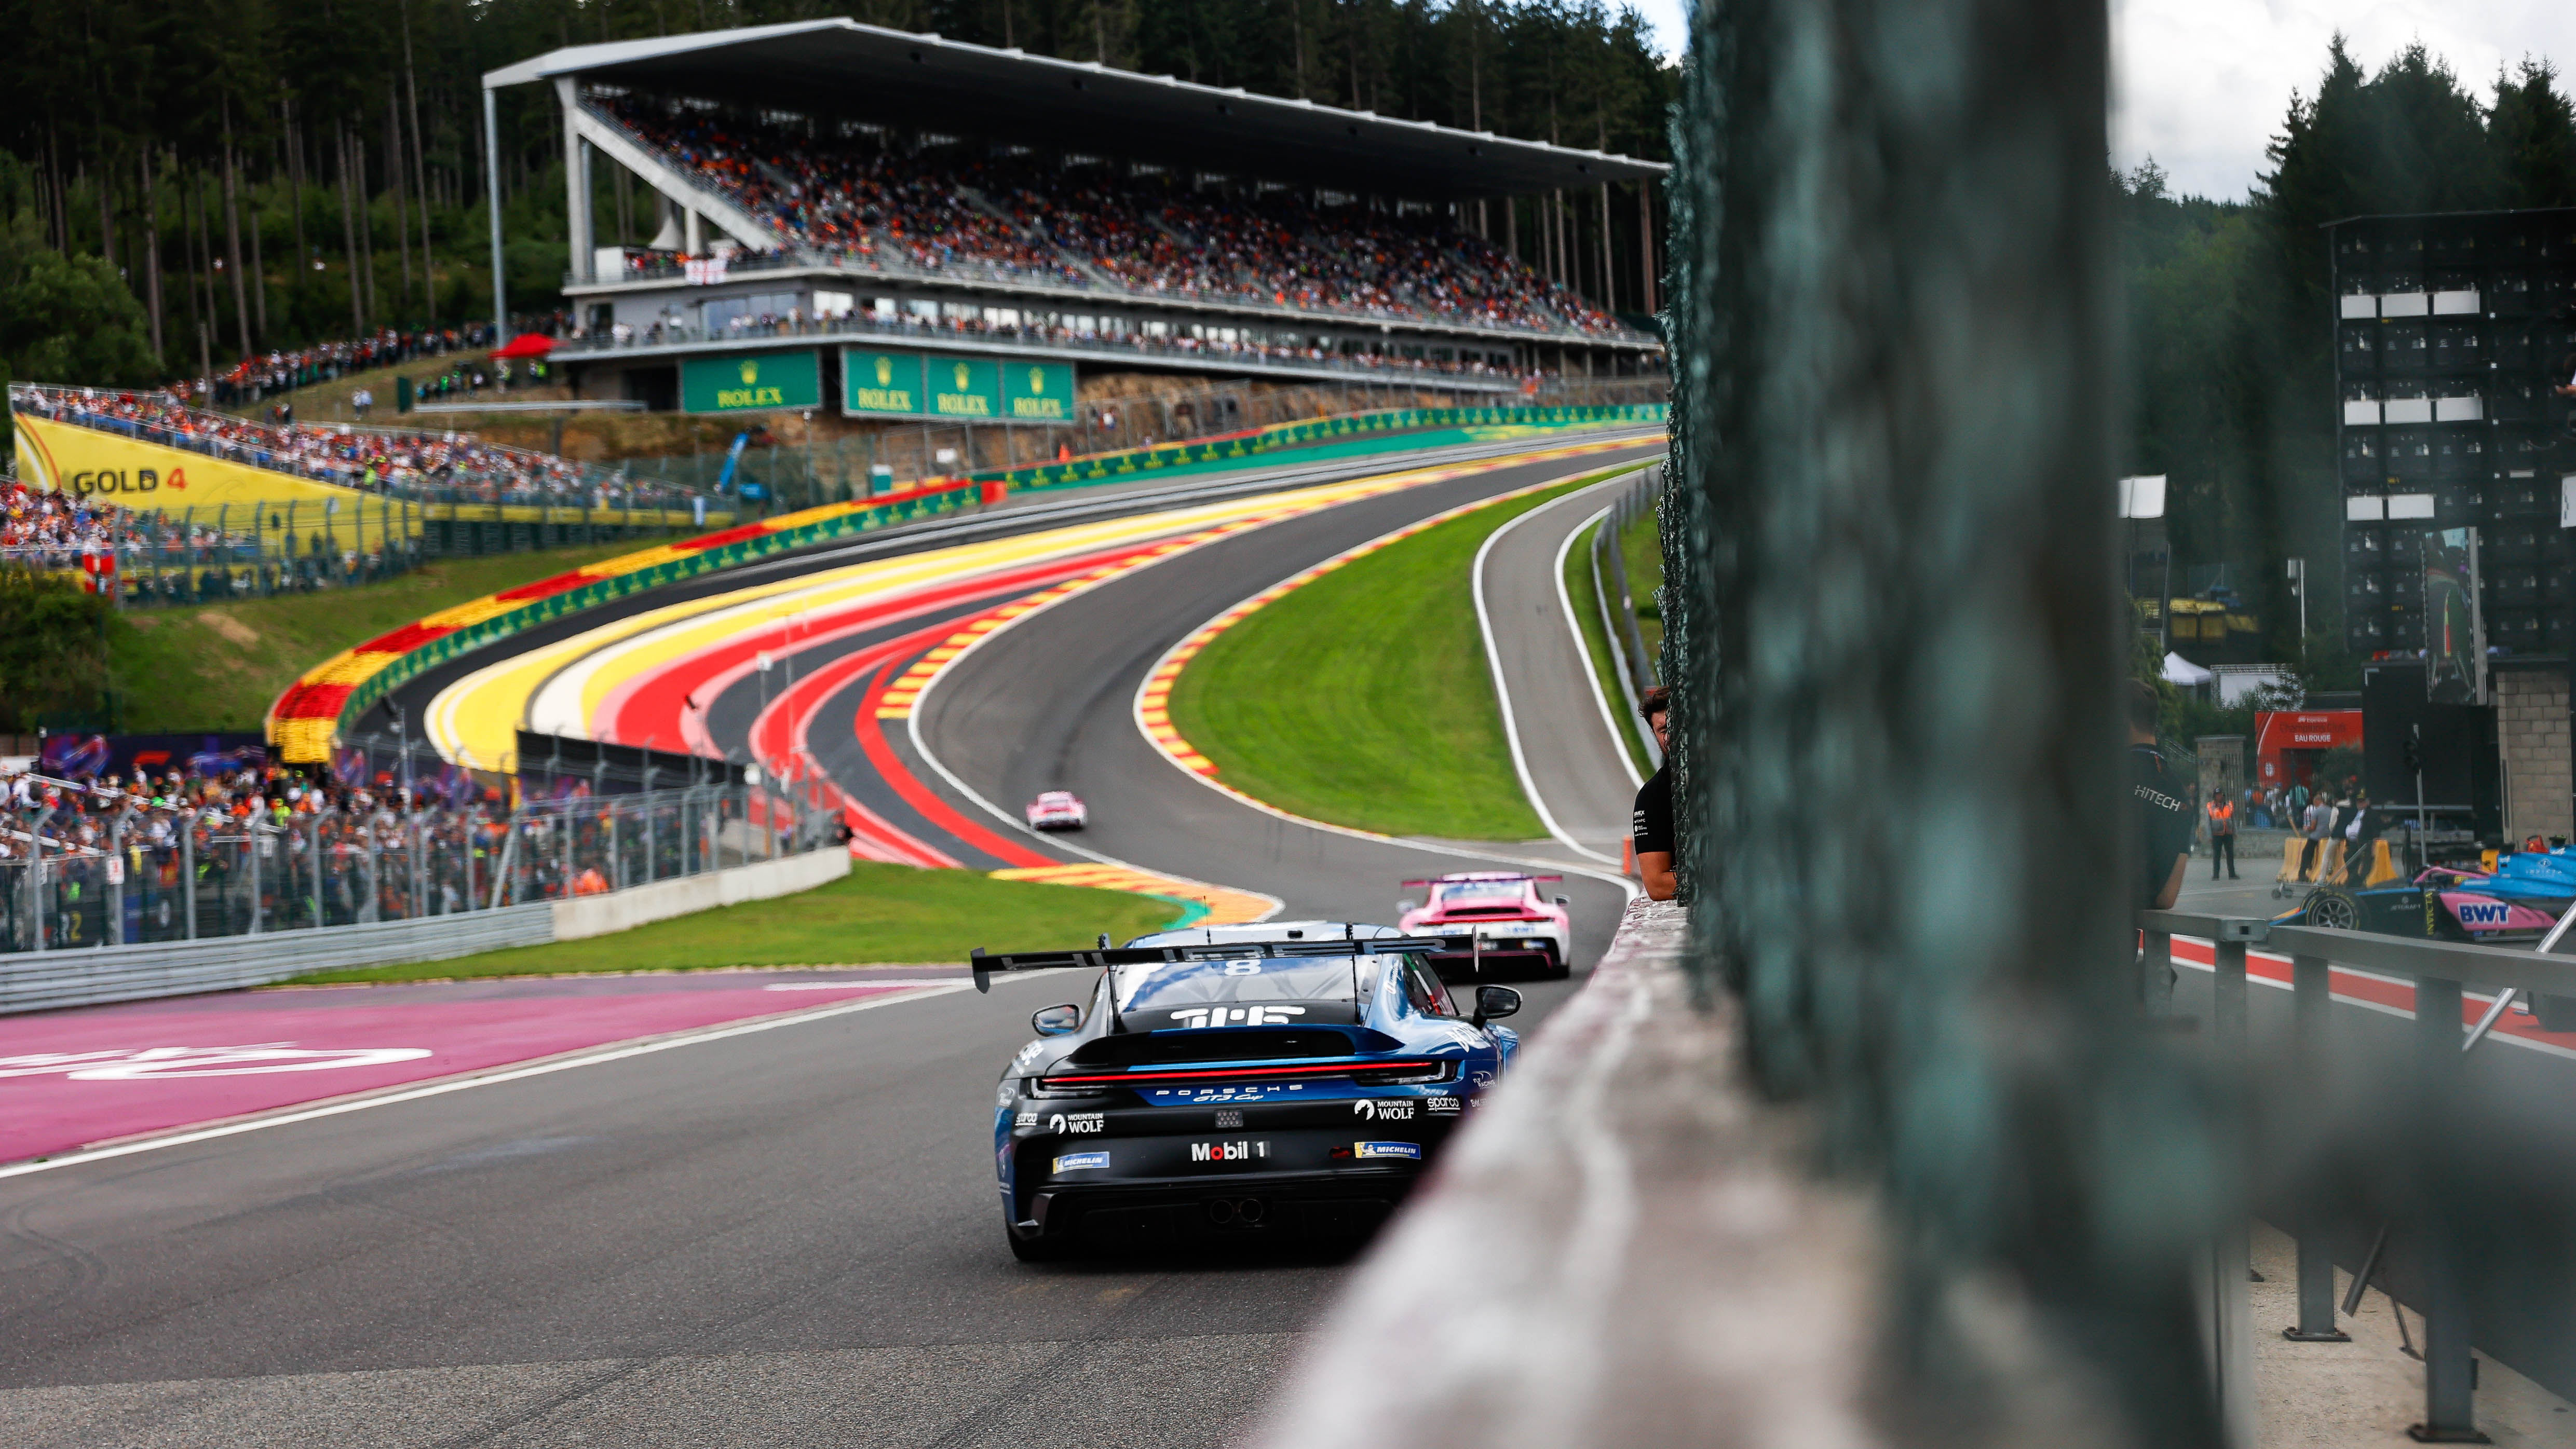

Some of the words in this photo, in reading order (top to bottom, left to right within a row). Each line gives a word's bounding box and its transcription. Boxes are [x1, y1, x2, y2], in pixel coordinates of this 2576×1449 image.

[717, 387, 783, 407] ROLEX
[858, 387, 912, 411] ROLEX
[938, 393, 989, 415] ROLEX
[1013, 397, 1062, 417] ROLEX
[75, 469, 158, 494] GOLD
[167, 467, 188, 489] 4
[2134, 784, 2180, 811] HITECH
[2459, 906, 2509, 922] BWT
[1225, 958, 1262, 976] 8
[1156, 1084, 1303, 1096] PORSCHE
[1377, 1108, 1414, 1120] WOLF
[1427, 1097, 1459, 1112] sparco
[1068, 1120, 1104, 1133] WOLF
[1191, 1141, 1248, 1161] Mobil
[1257, 1142, 1265, 1157] 1
[1064, 1157, 1103, 1166] MICHELIN
